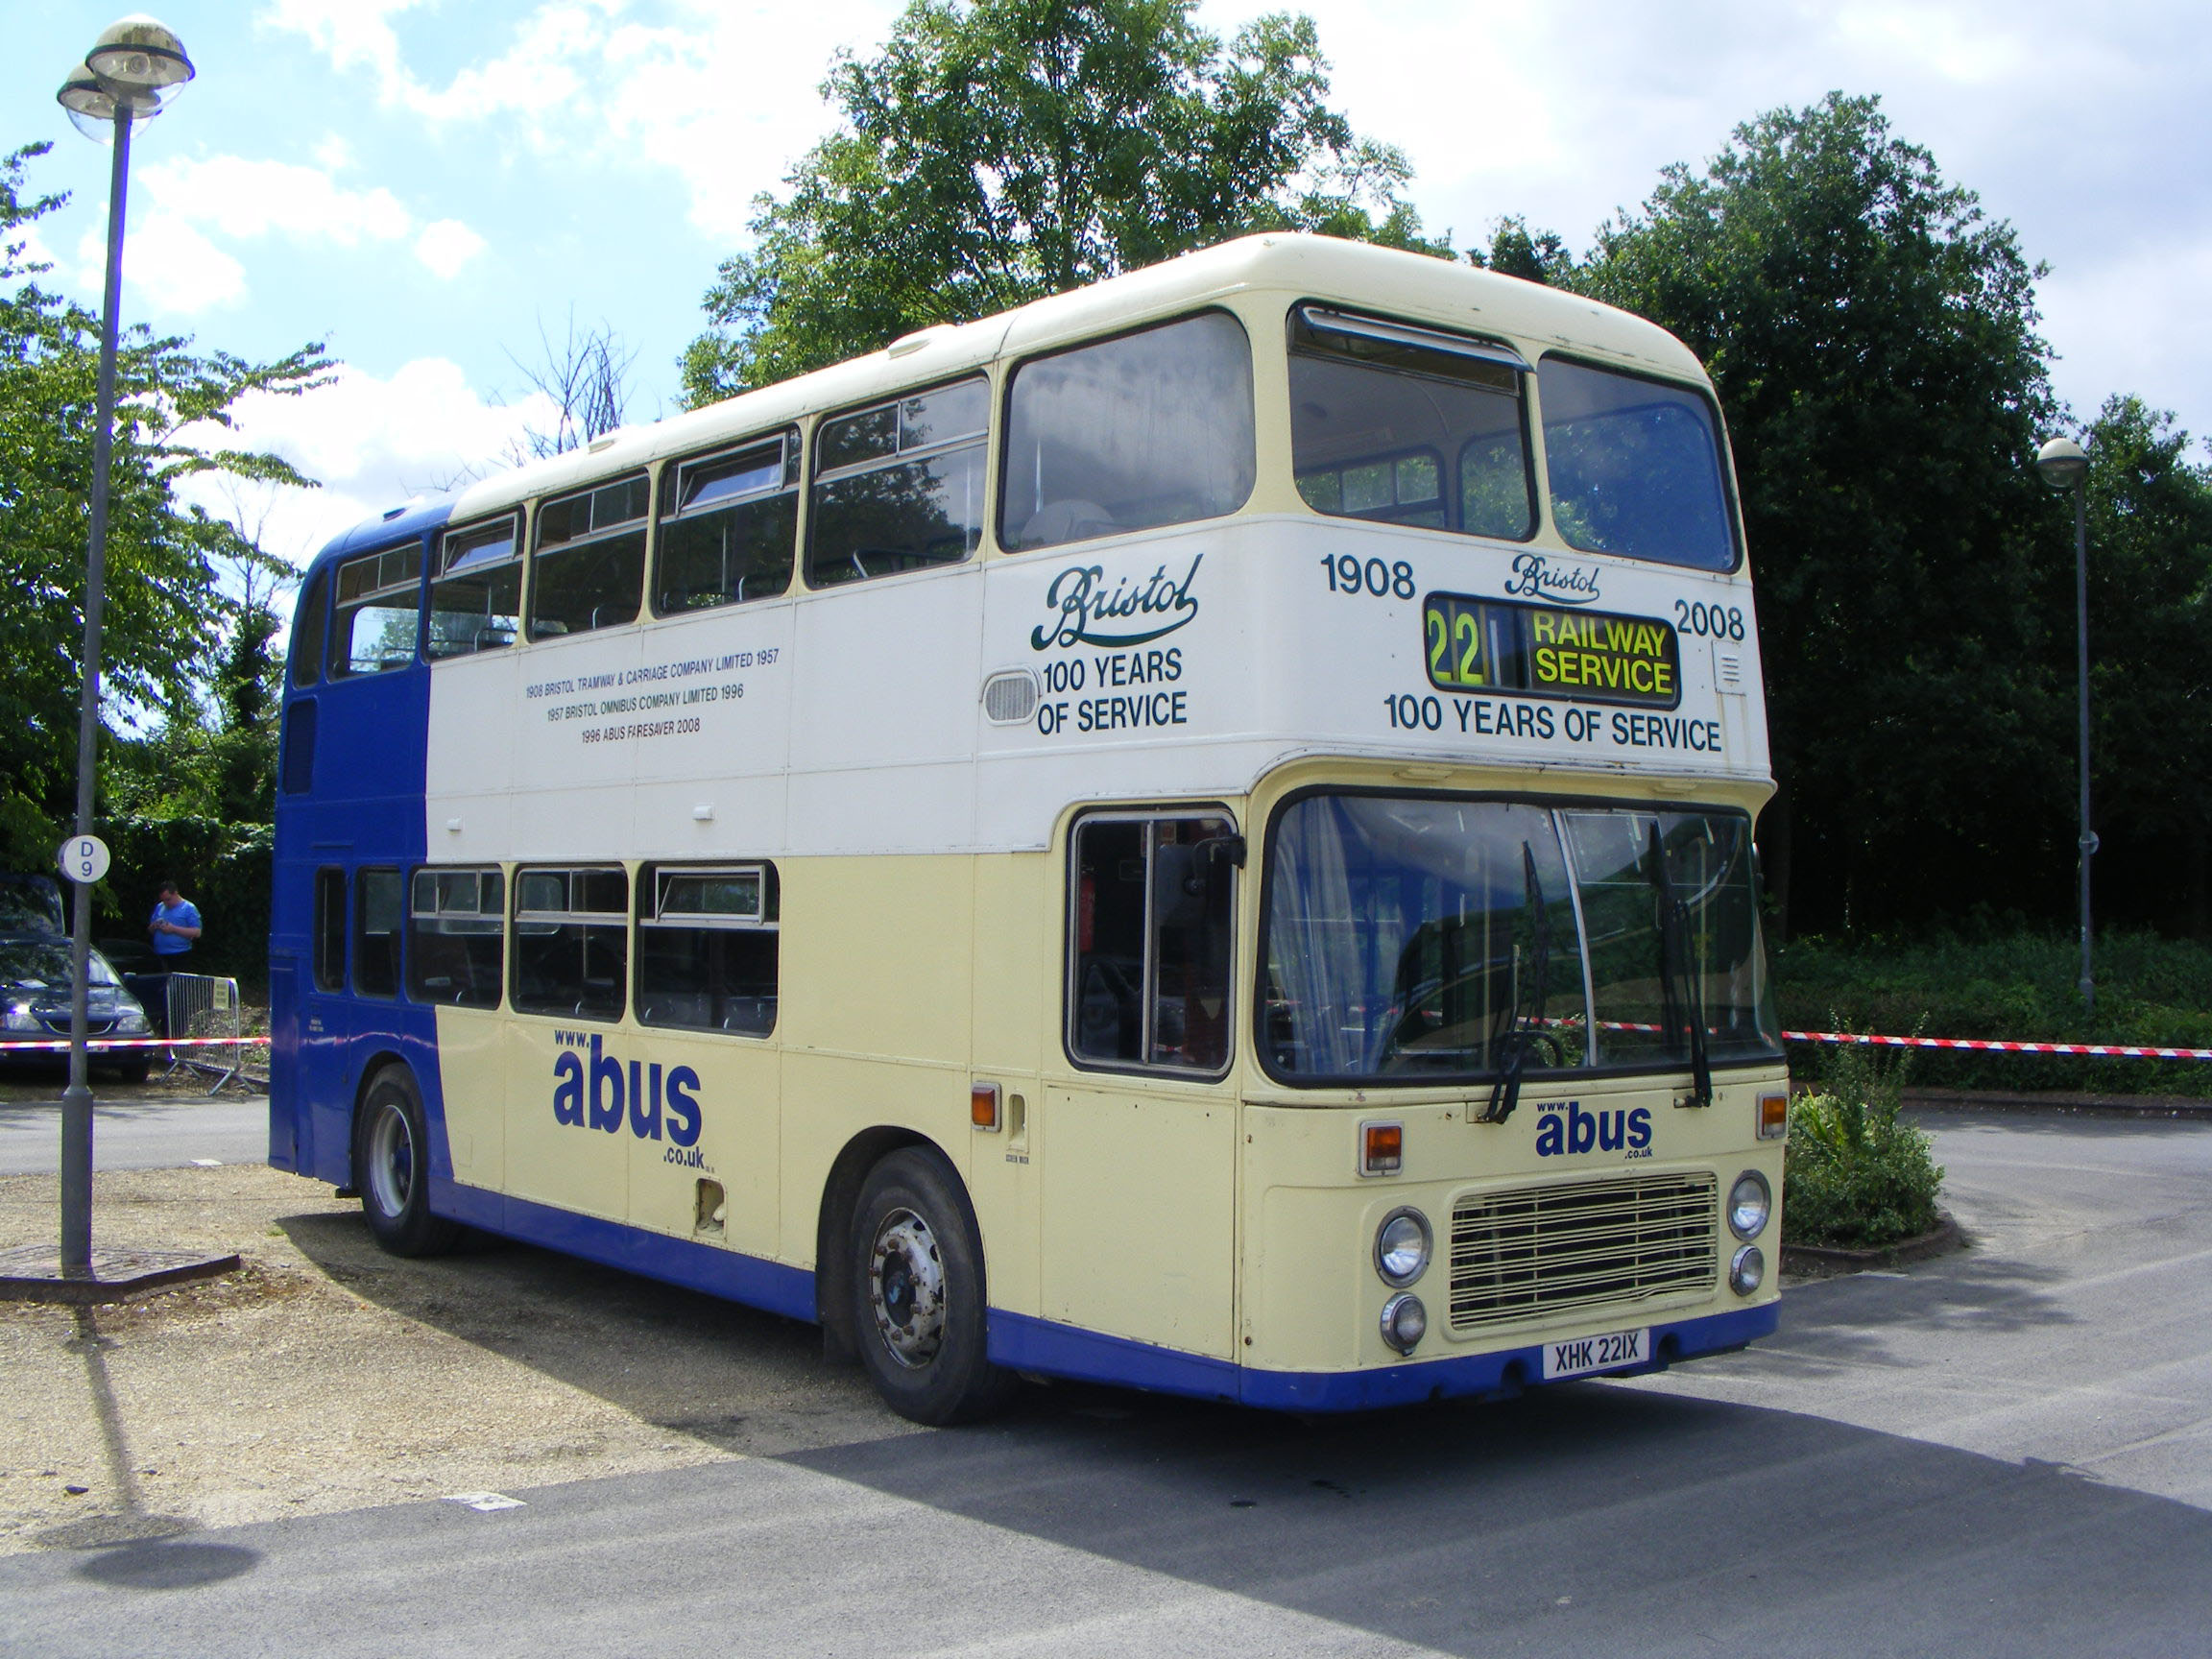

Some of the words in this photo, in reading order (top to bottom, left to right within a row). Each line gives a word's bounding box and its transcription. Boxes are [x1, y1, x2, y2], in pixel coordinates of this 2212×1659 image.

[1320, 554, 1415, 600] 1908
[1504, 554, 1600, 604] Bristol
[1031, 553, 1204, 650] Bristol
[1674, 599, 1744, 641] 2008
[1428, 609, 1484, 685] 22
[1533, 611, 1668, 658] RAILWAY
[526, 684, 543, 699] 1908
[544, 680, 575, 696] BRISTOL
[578, 674, 615, 691] TRAMWAY
[617, 672, 624, 685] &
[626, 665, 668, 685] CARRIAGE
[670, 659, 714, 678] COMPANY
[716, 653, 754, 671] LIMITED
[757, 648, 780, 665] 1957
[1044, 659, 1086, 693] 100
[1095, 648, 1182, 687] YEARS
[1536, 648, 1673, 694] SERVICE
[547, 707, 565, 722] 1957
[565, 703, 597, 719] BRISTOL
[600, 697, 637, 714] OMNIBUS
[639, 691, 681, 710] COMPANY
[683, 686, 718, 705] LIMITED
[721, 684, 744, 700] 1996
[1038, 703, 1070, 735] OF
[1077, 691, 1188, 732] SERVICE
[1383, 694, 1442, 731] 100
[1453, 699, 1555, 739] YEARS
[1565, 709, 1601, 742] OF
[1612, 712, 1722, 752] SERVICE
[582, 729, 601, 743] 1996
[603, 726, 625, 741] ABUS
[627, 720, 675, 738] FARESAVER
[677, 717, 700, 733] 2008
[81, 842, 94, 856] D
[82, 861, 92, 877] 9
[555, 1030, 589, 1047] www.
[553, 1033, 702, 1147] abus
[1537, 1102, 1569, 1112] www.
[1536, 1101, 1652, 1157] abus
[663, 1146, 705, 1169] .co.uk
[1624, 1146, 1652, 1159] .co.uk
[1556, 1340, 1593, 1371] XHK
[1599, 1333, 1638, 1363] 221X
